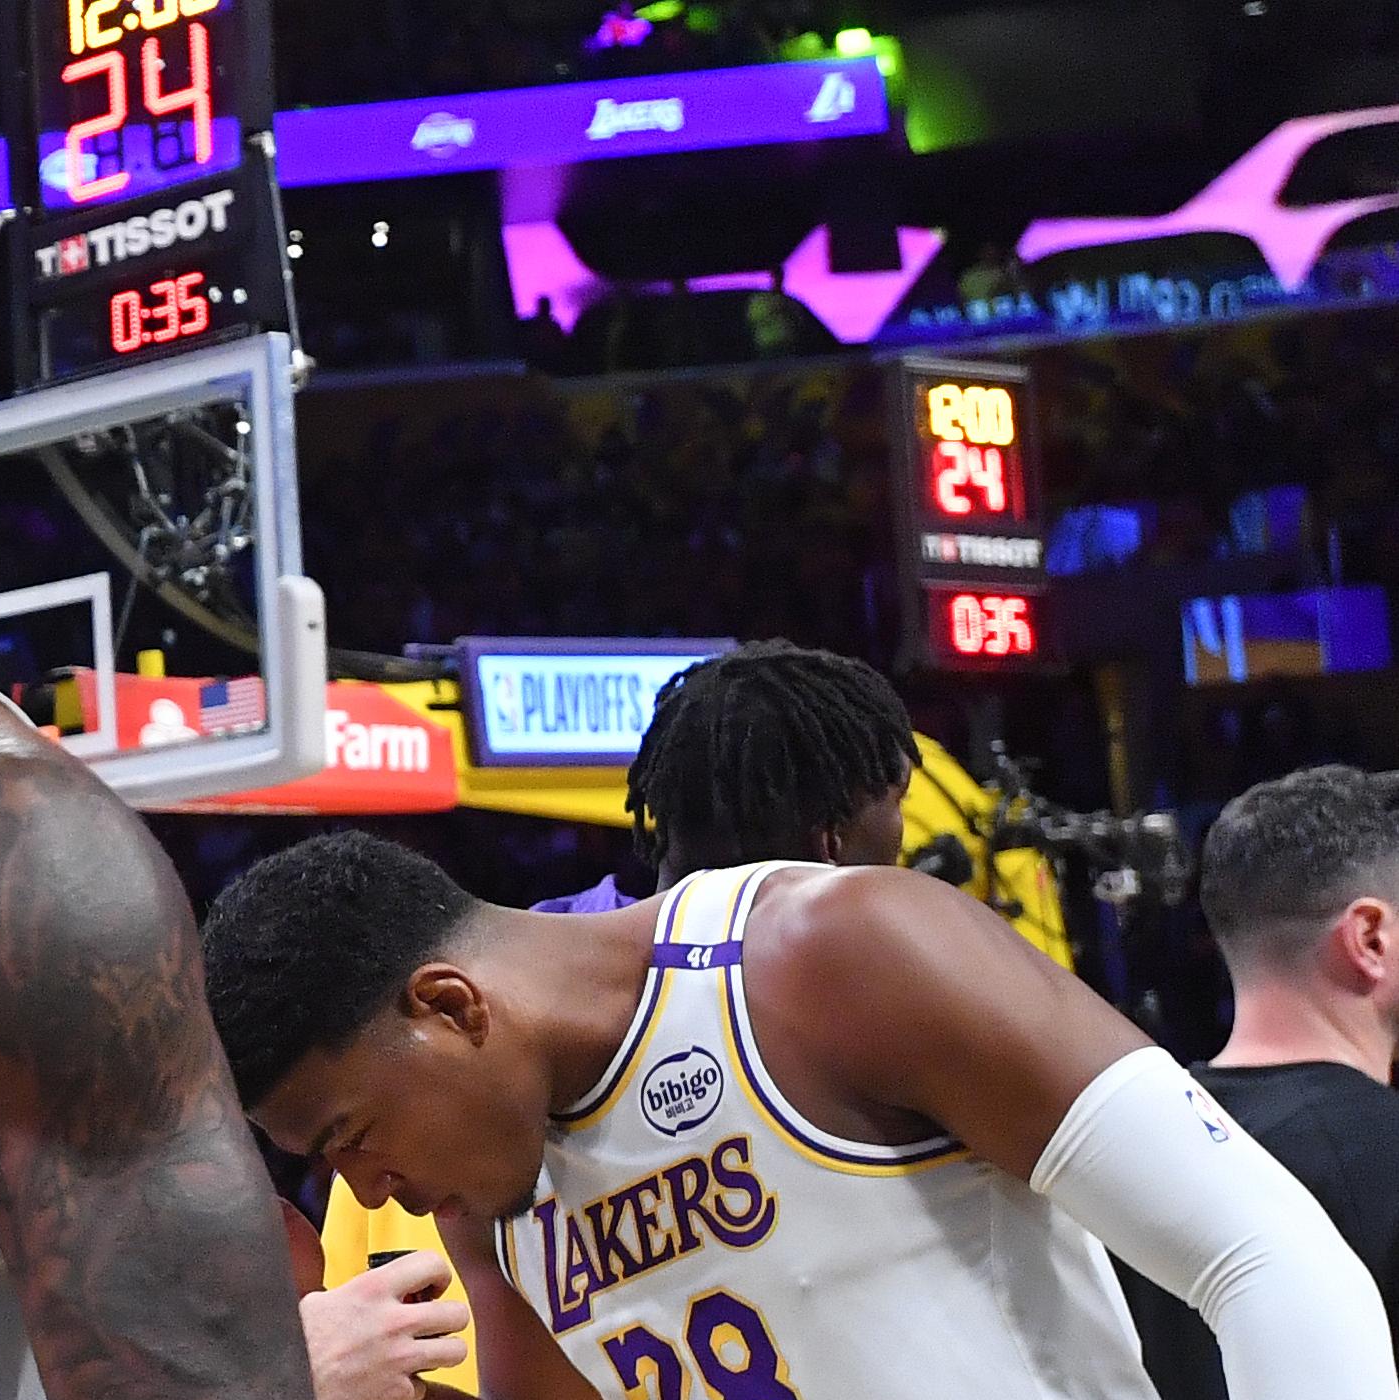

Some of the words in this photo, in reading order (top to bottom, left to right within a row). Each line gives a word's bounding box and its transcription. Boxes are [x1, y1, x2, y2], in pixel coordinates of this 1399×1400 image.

[62, 22, 213, 203] 24
[87, 189, 234, 266] TISSOT
[110, 271, 210, 353] 0:35
[936, 440, 1007, 513] 24
[520, 671, 644, 733] PLAYOFFS
[324, 709, 430, 773] Farm
[687, 946, 713, 968] 44
[647, 1067, 717, 1112] bibigo
[532, 1135, 781, 1340] LAKERS
